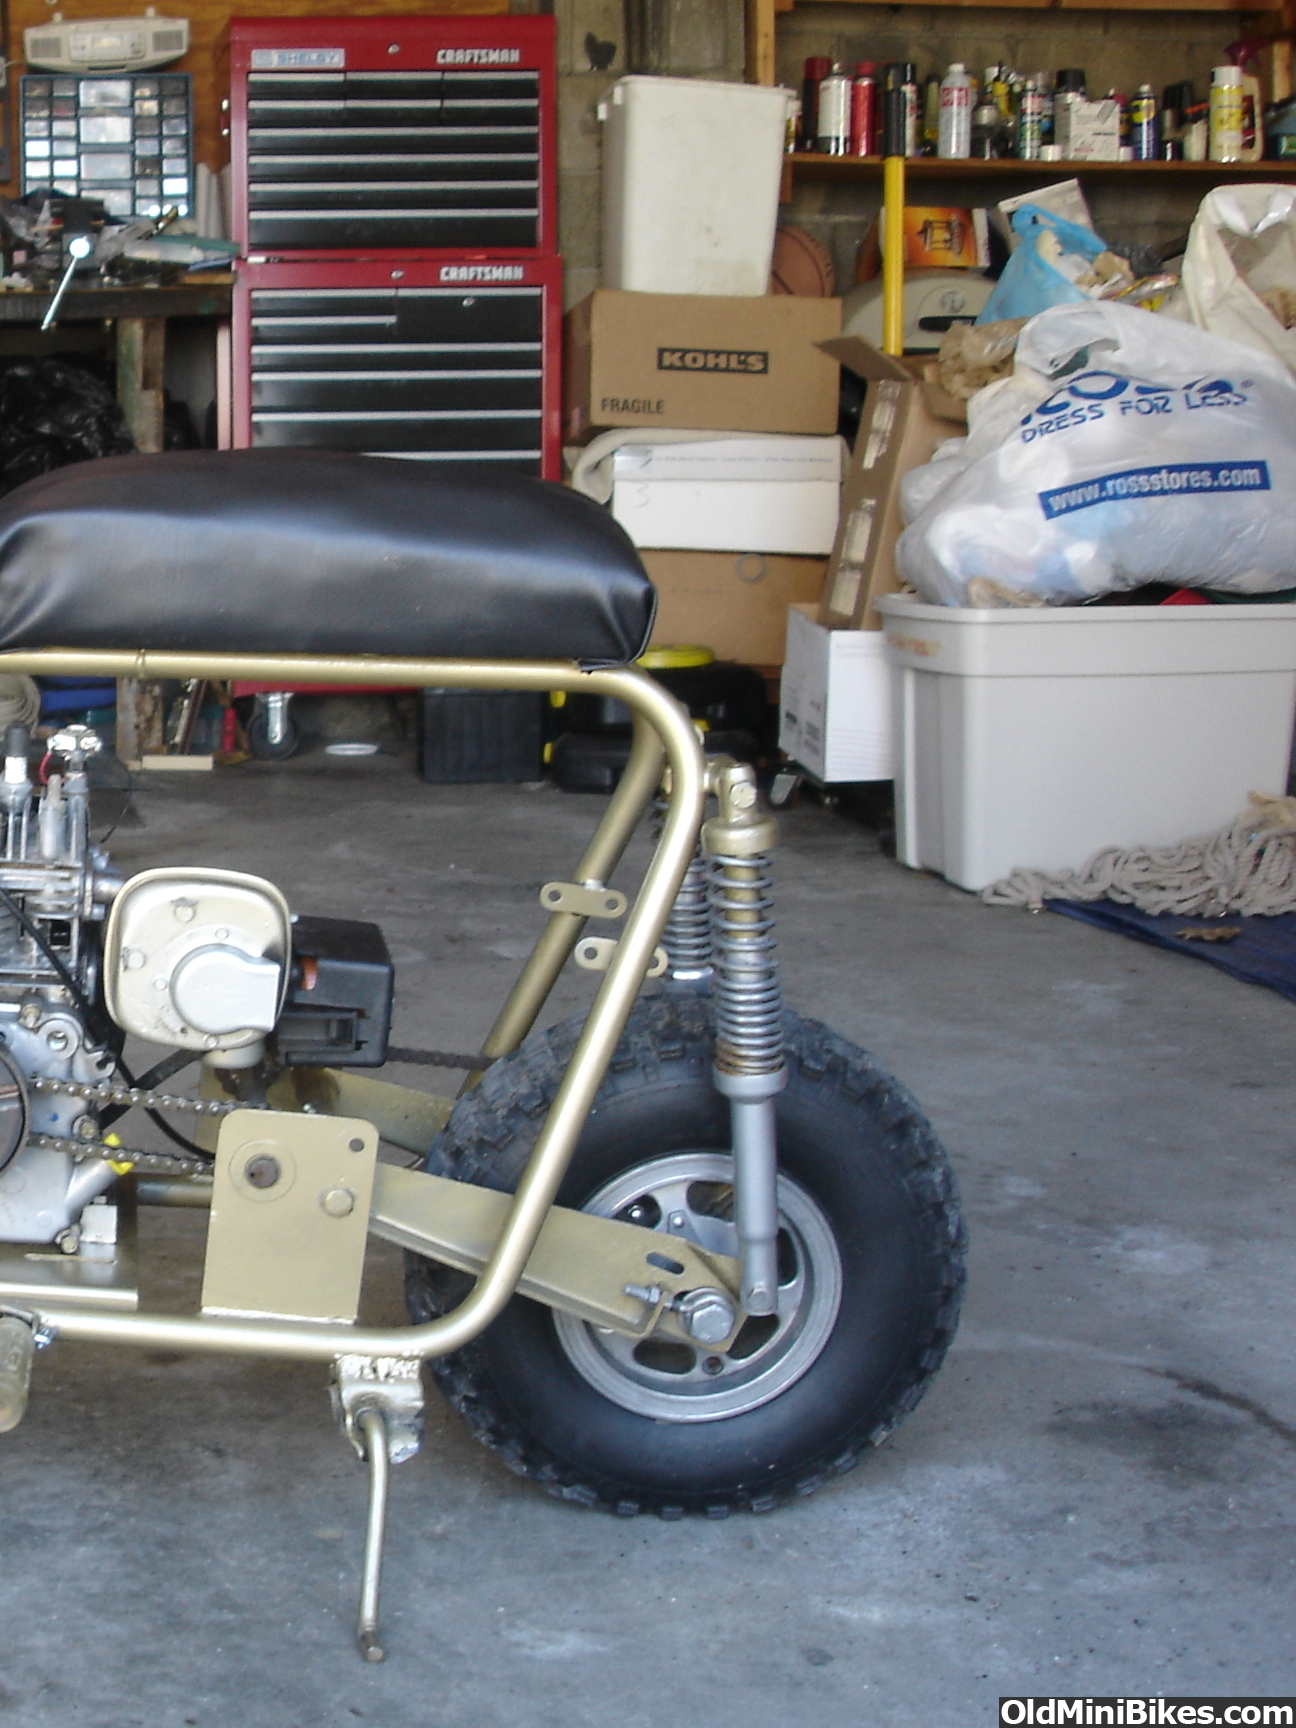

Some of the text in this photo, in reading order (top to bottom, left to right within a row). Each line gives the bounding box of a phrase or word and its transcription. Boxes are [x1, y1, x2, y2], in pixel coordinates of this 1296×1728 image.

[436, 49, 520, 64] CRAFTSMAN
[440, 265, 523, 281] CRAFTSMAN
[661, 350, 766, 372] KOHL'S
[601, 398, 666, 415] FRAGILE
[1022, 403, 1105, 443] DRESS
[1119, 395, 1173, 416] FOR
[1049, 466, 1261, 511] www.rossstores.com
